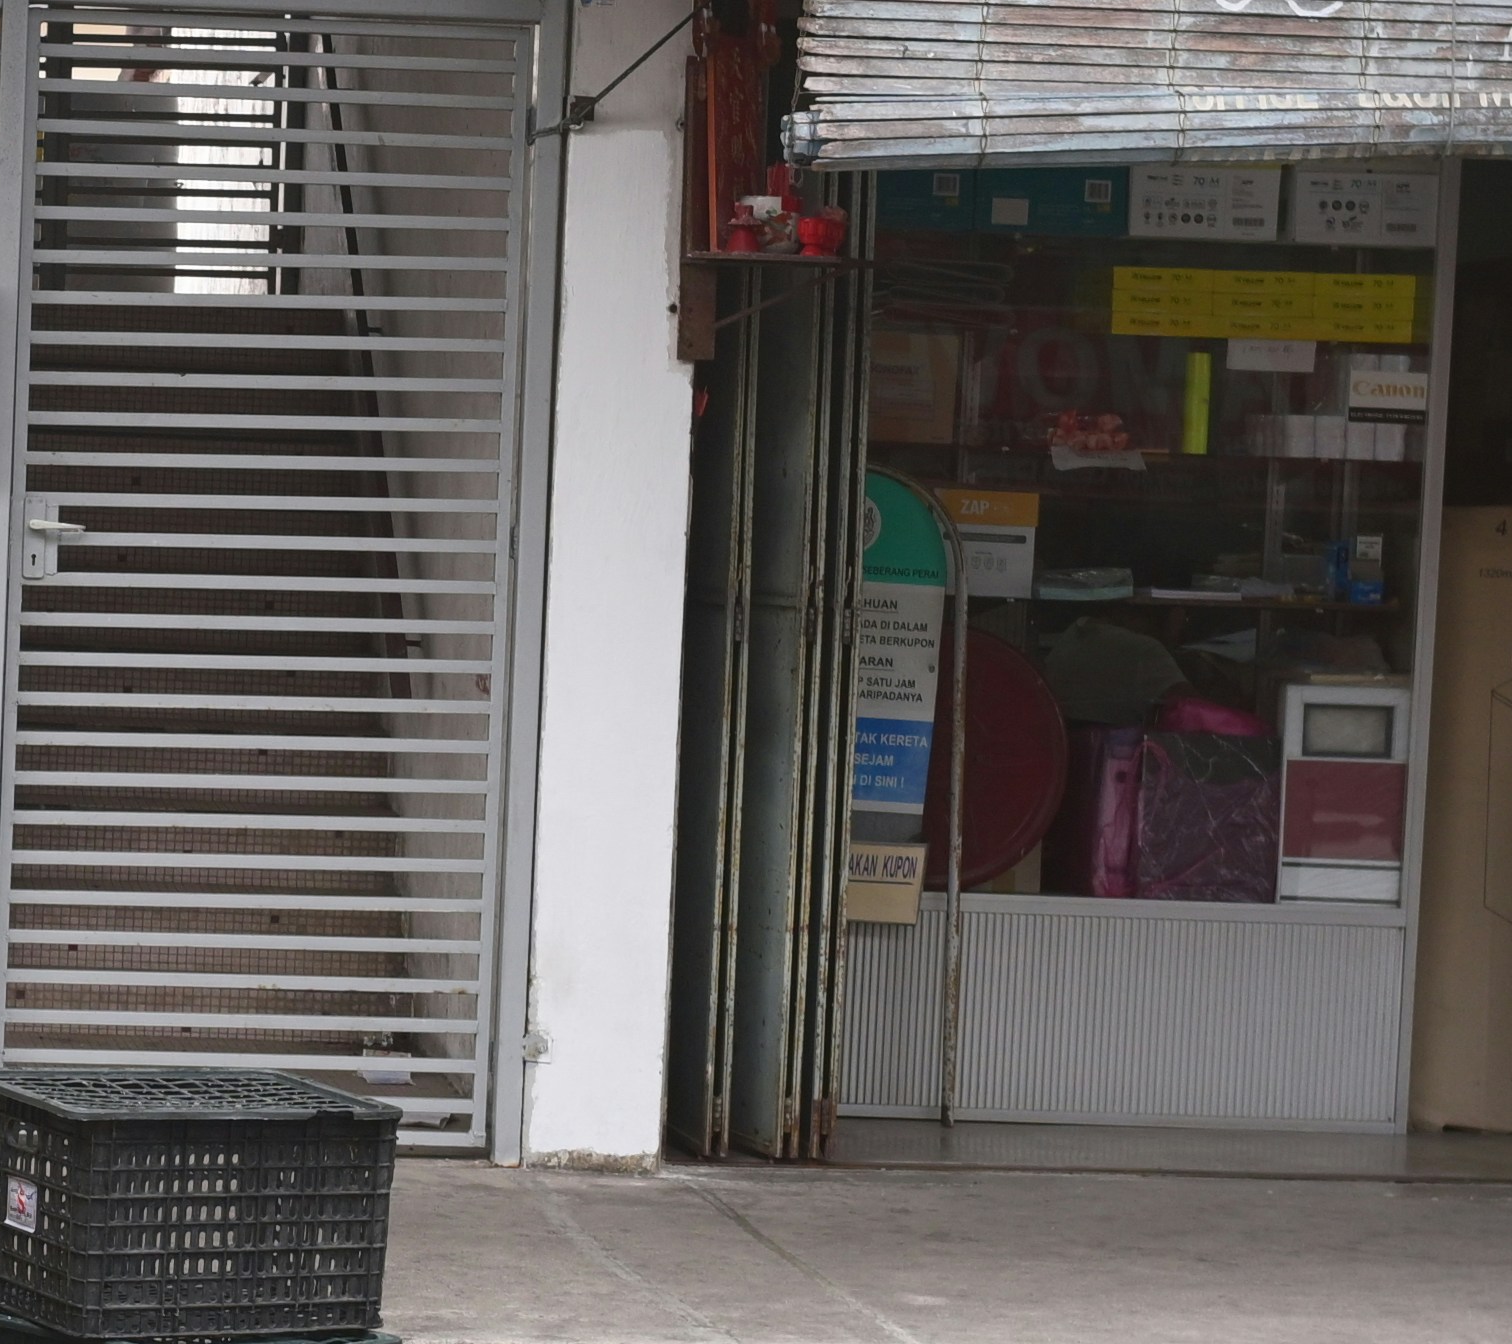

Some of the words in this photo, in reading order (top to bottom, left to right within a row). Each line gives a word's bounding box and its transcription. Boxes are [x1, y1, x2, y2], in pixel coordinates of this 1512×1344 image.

[1353, 381, 1426, 399] Canon
[1495, 519, 1507, 537] 4
[858, 598, 898, 611] HUAN
[879, 636, 936, 649] BERKUPON
[867, 677, 894, 688] SATU
[895, 677, 916, 689] JAM
[880, 733, 928, 748] KERETA
[875, 775, 898, 788] SINI
[882, 855, 917, 878] KUPON
